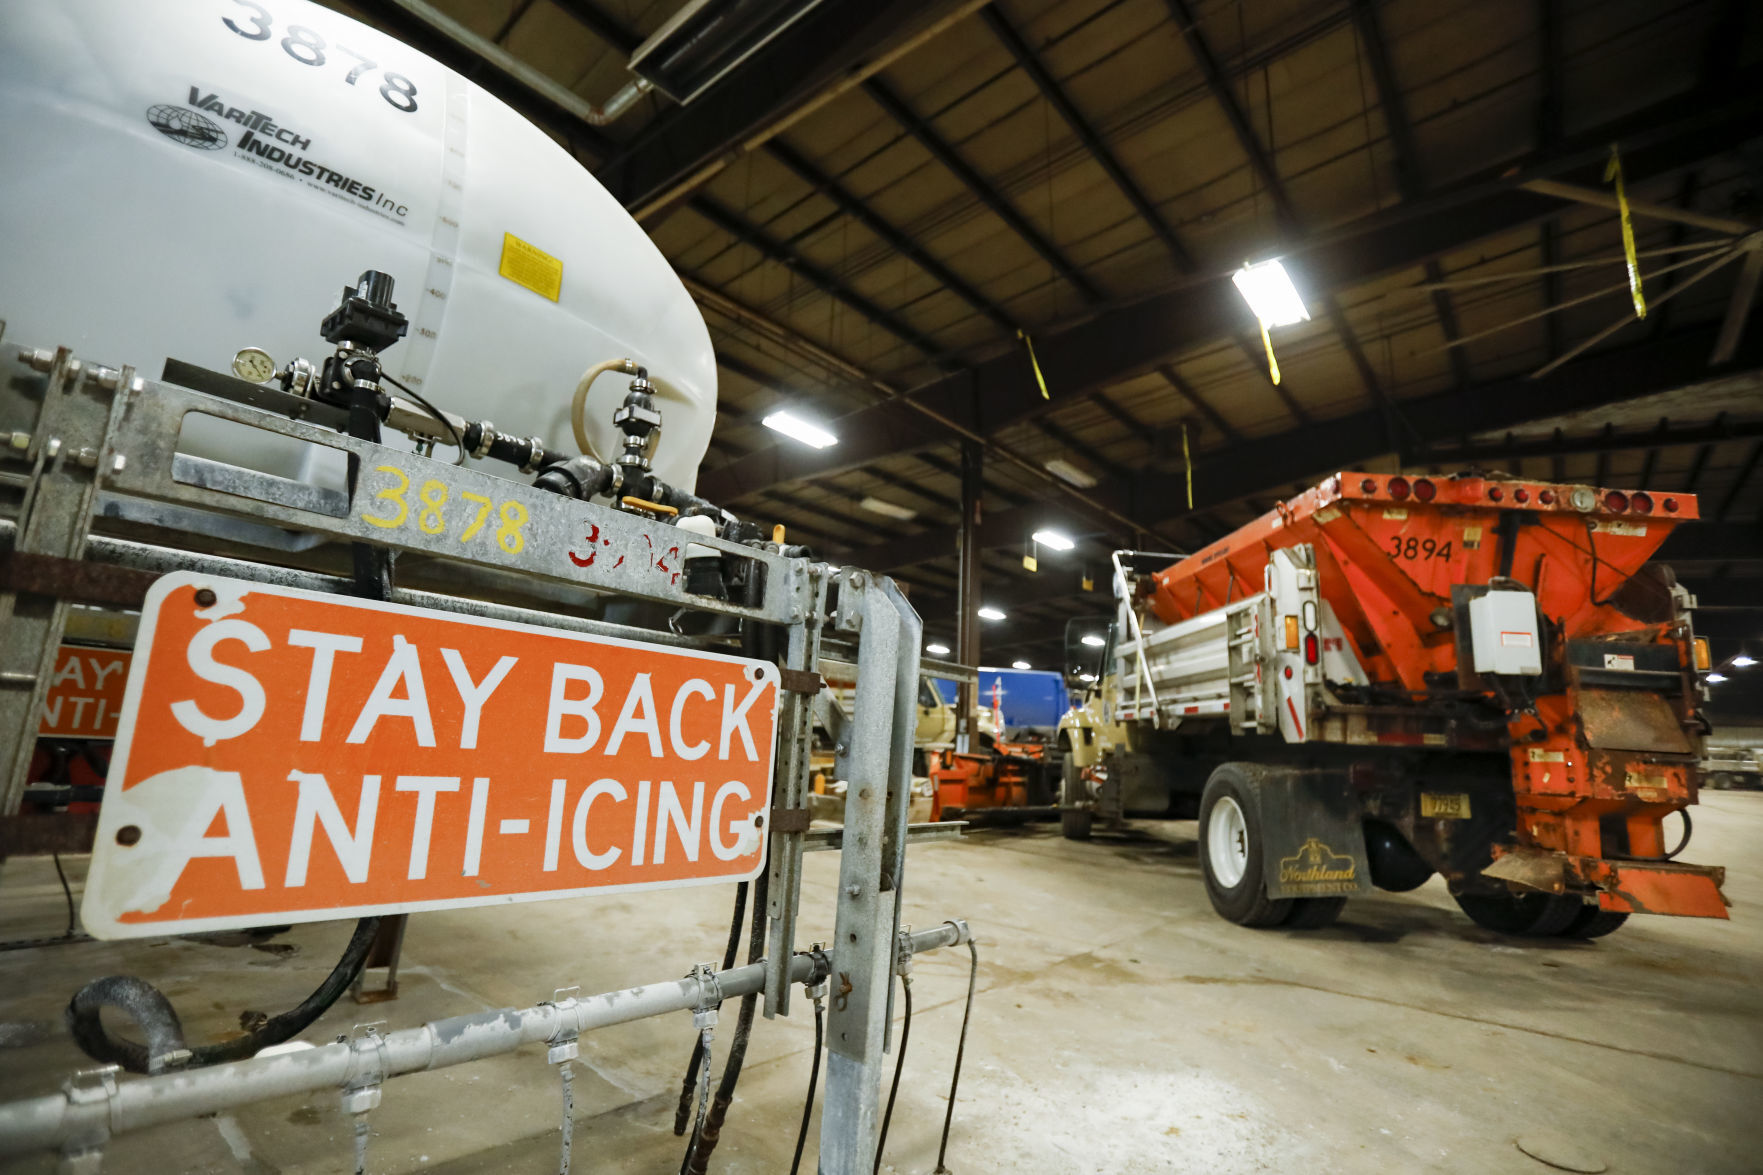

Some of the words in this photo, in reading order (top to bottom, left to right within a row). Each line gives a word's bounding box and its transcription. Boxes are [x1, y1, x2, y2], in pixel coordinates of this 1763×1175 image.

[222, 0, 418, 112] 3878
[376, 193, 408, 217] Inc
[361, 465, 530, 554] 3878
[1388, 535, 1453, 563] 3894
[53, 655, 124, 690] AY
[170, 618, 519, 750] STAY
[543, 662, 766, 762] BACK
[150, 768, 754, 891] ANTI-ICING
